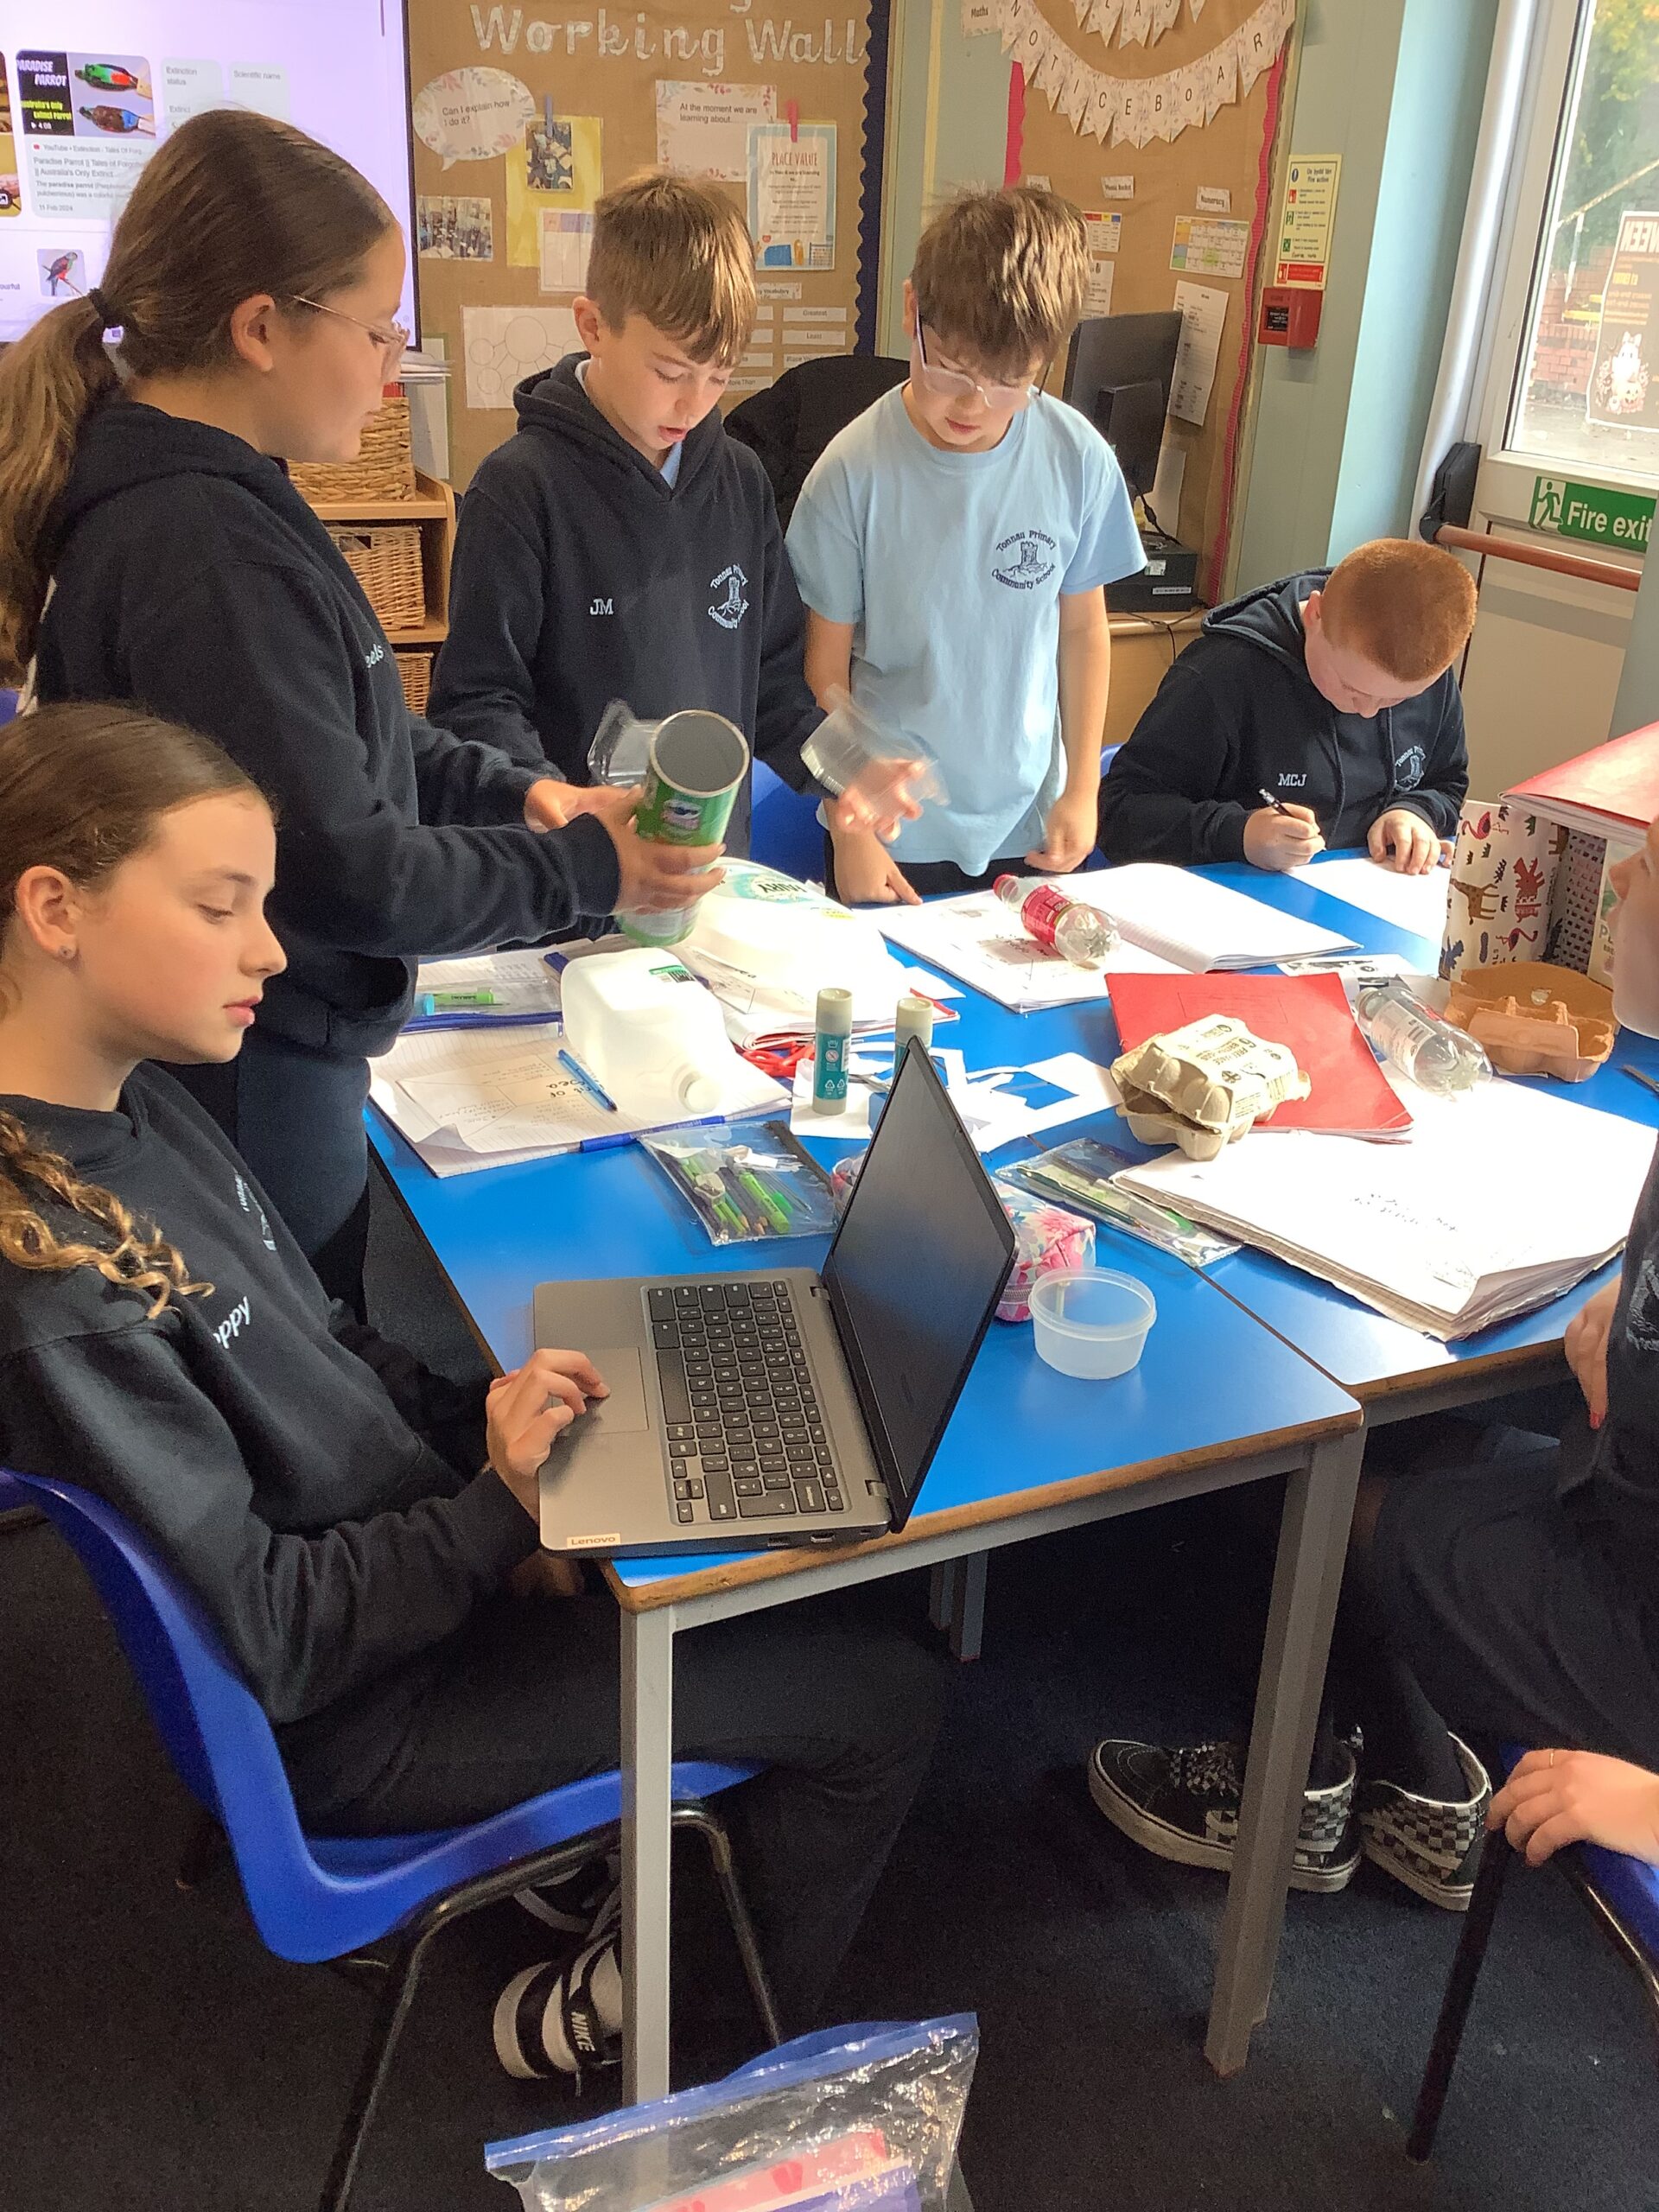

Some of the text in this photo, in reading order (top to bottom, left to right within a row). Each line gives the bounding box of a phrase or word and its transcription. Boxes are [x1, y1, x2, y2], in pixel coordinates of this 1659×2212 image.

[970, 5, 988, 18] Maths
[470, 4, 865, 76] Working Wall
[166, 67, 197, 75] Extinction
[233, 70, 262, 79] Scientific
[442, 107, 459, 116] Can
[466, 103, 493, 114] explain
[494, 100, 510, 110] how
[702, 105, 732, 113] moment
[450, 117, 459, 126] do
[461, 115, 471, 125] it?
[680, 113, 709, 124] learning
[34, 157, 62, 166] Paradise
[64, 158, 85, 167] Parrot
[772, 152, 817, 166] PLACE VALUE
[76, 169, 91, 179] Only
[1567, 501, 1652, 543] Fire exit
[1029, 529, 1057, 550] Primary
[991, 569, 1034, 589] Community
[589, 598, 614, 615] JM
[1278, 772, 1306, 787] MCJ
[570, 1536, 616, 1545] Lenovo
[571, 2011, 595, 2052] NIKE
